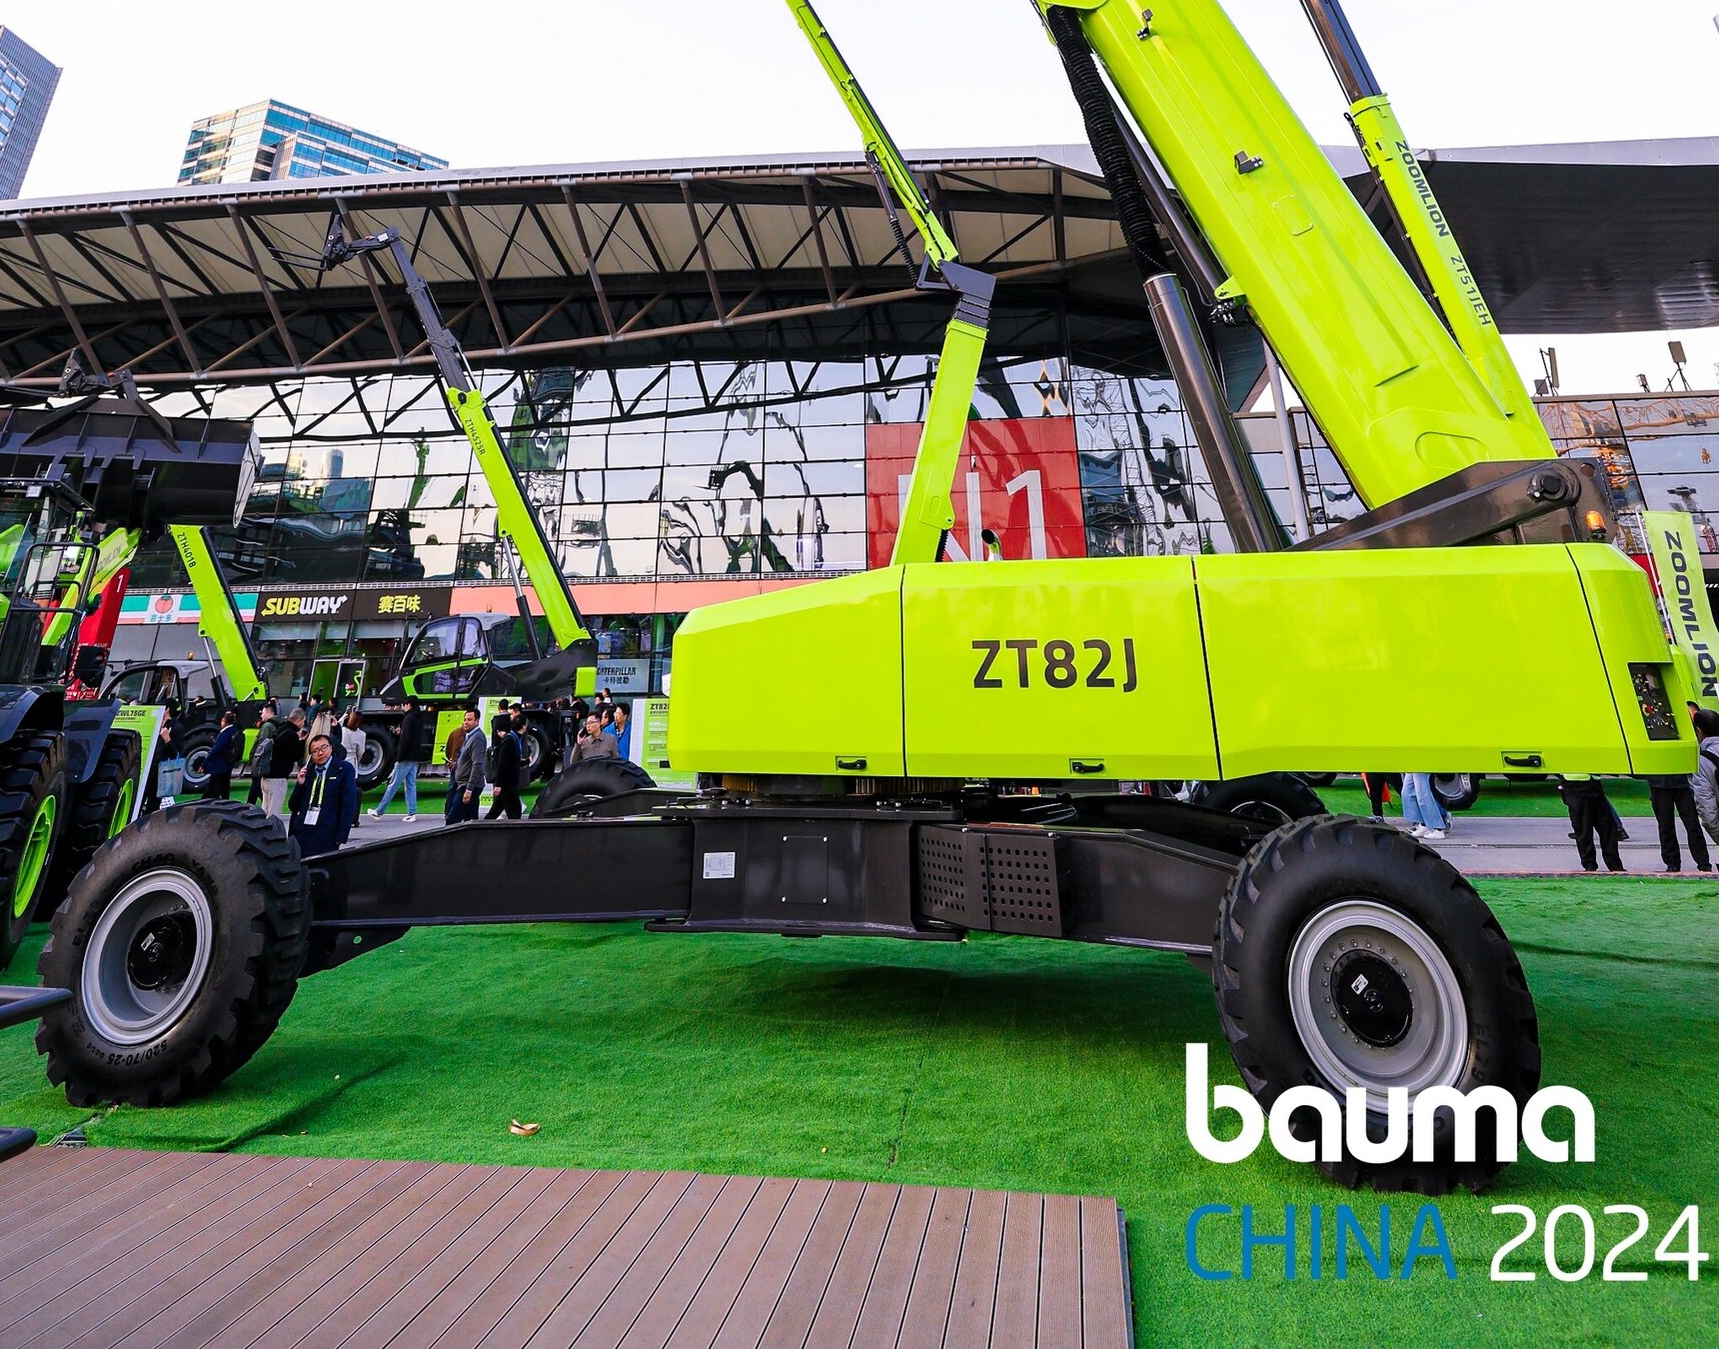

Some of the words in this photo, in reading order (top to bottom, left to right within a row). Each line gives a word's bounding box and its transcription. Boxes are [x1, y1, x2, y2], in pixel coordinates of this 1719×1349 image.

[1395, 139, 1450, 238] ZOOMLION
[1450, 255, 1492, 326] ZT51JEH
[465, 418, 486, 456] ZTH4525R
[261, 594, 348, 617] SUBWAY
[377, 594, 421, 614] 赛百味
[1664, 529, 1718, 697] ZOOMLION
[971, 638, 1138, 693] ZT82J
